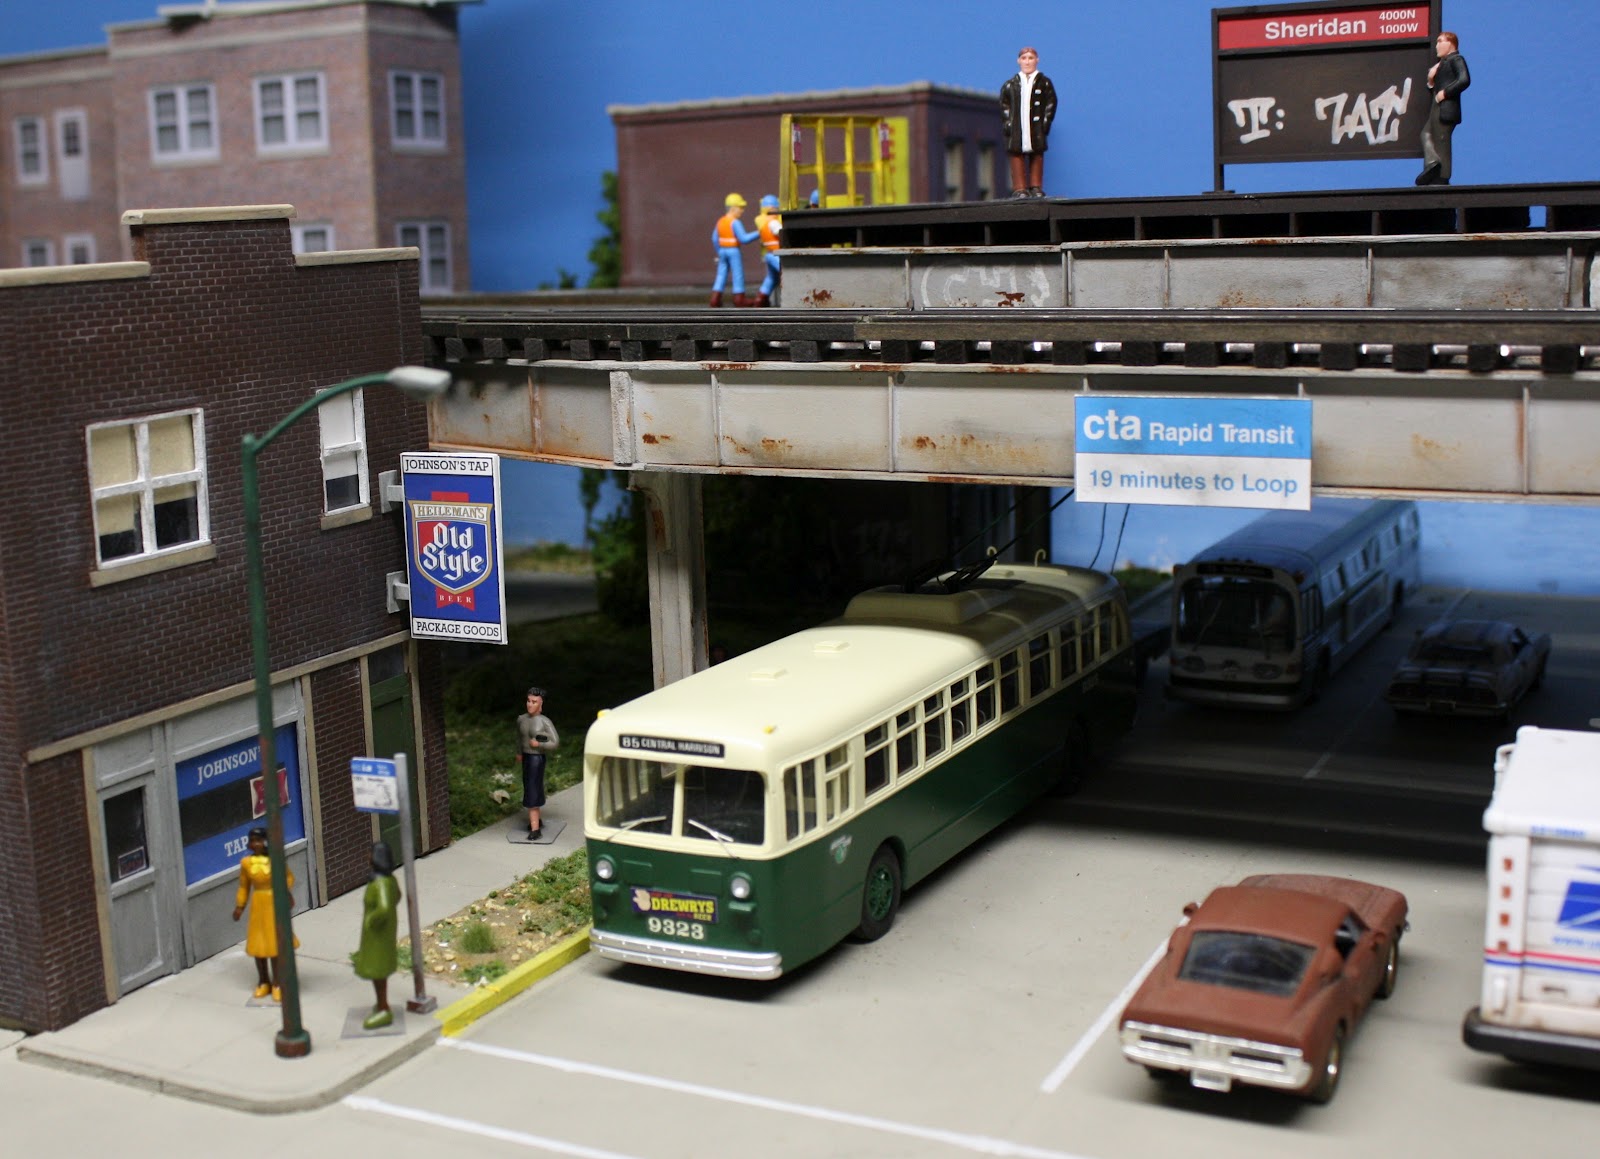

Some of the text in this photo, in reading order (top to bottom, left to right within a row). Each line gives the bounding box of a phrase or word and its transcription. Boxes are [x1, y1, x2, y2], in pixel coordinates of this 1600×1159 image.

[1379, 9, 1416, 21] 4000N
[1265, 18, 1367, 40] Sheridan
[1379, 22, 1419, 34] 1000W
[1083, 409, 1295, 446] cta Rapid Transit
[405, 459, 489, 472] JOHNSON'S TAP
[1089, 470, 1298, 497] 19 minutes to Loop
[433, 522, 472, 551] Old
[423, 543, 484, 581] Style
[439, 594, 472, 604] BEER
[416, 621, 499, 637] PACKAGE GOODS
[622, 736, 640, 749] 85
[641, 738, 676, 751] CENTRAL
[197, 747, 262, 785] JOHNSON'
[651, 897, 714, 913] DREWRYS
[648, 916, 704, 940] 9323
